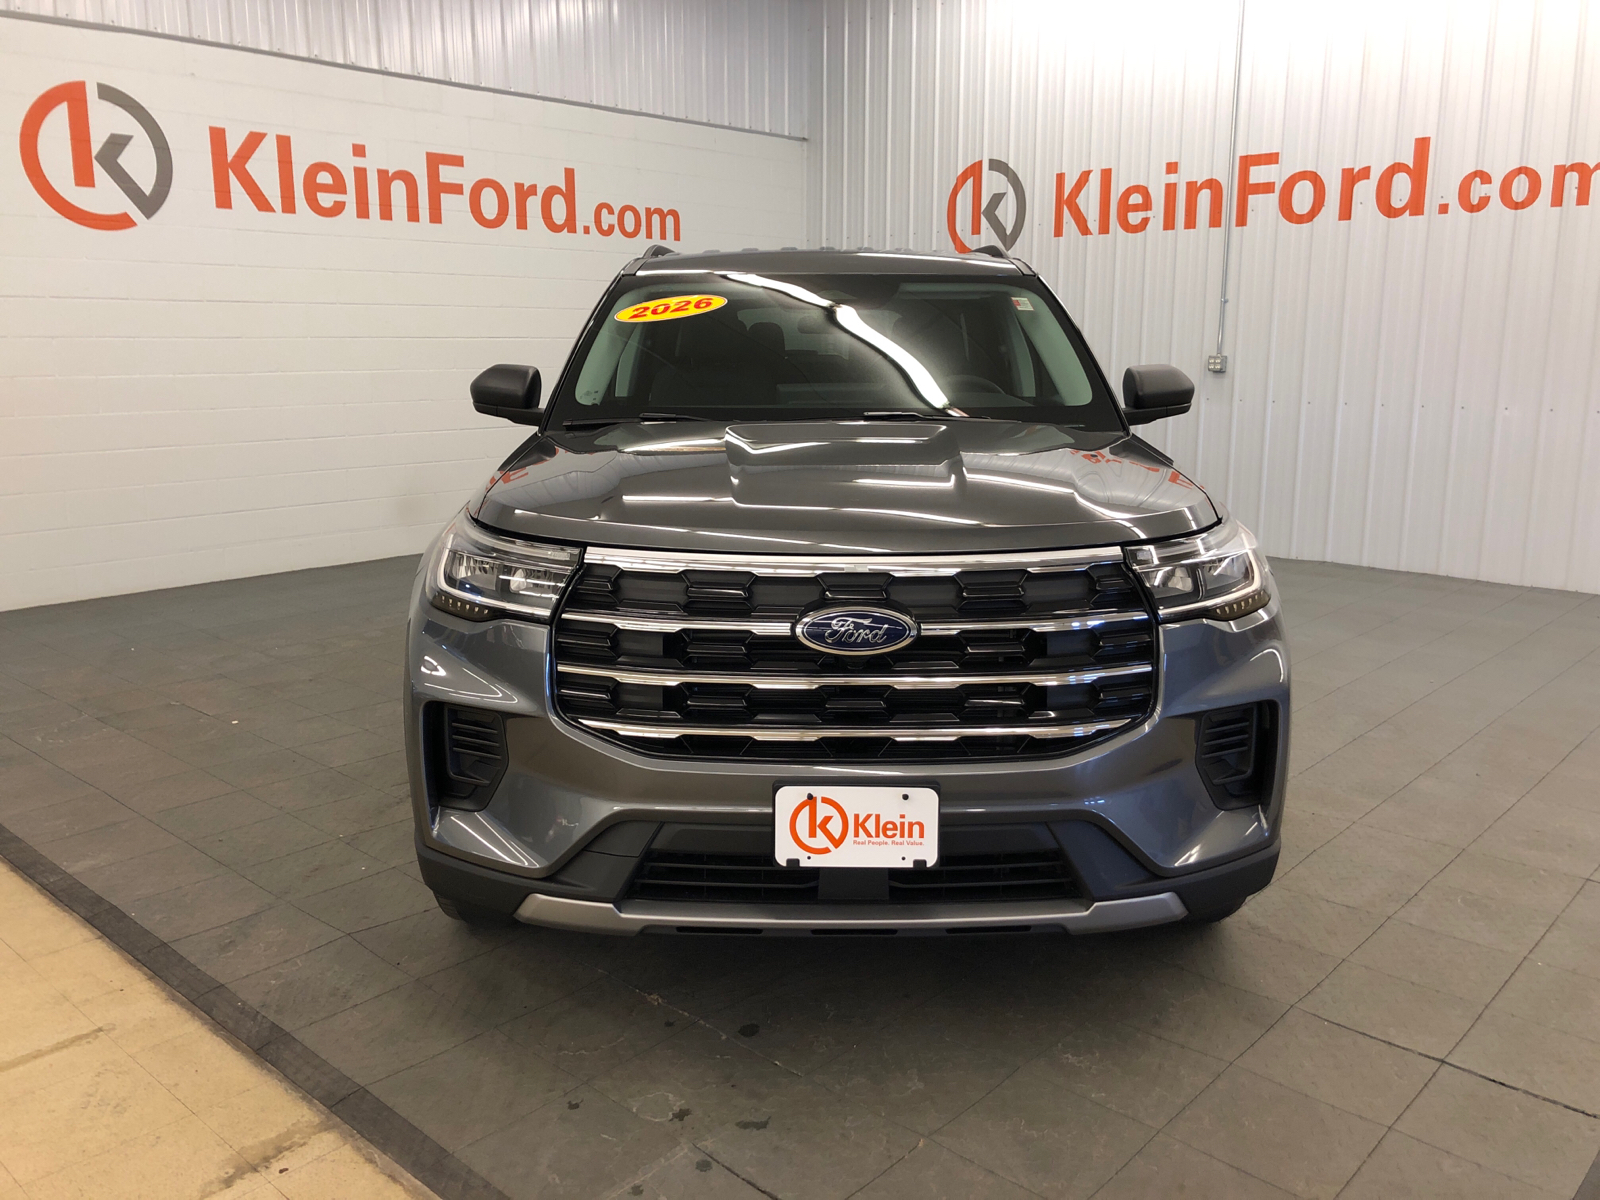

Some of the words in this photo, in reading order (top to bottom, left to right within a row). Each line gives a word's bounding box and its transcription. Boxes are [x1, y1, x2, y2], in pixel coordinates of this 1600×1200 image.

[208, 126, 682, 242] KleinFord.com
[628, 298, 713, 320] 2026
[825, 616, 902, 643] Ford
[853, 813, 925, 839] Klein
[868, 839, 890, 847] People.
